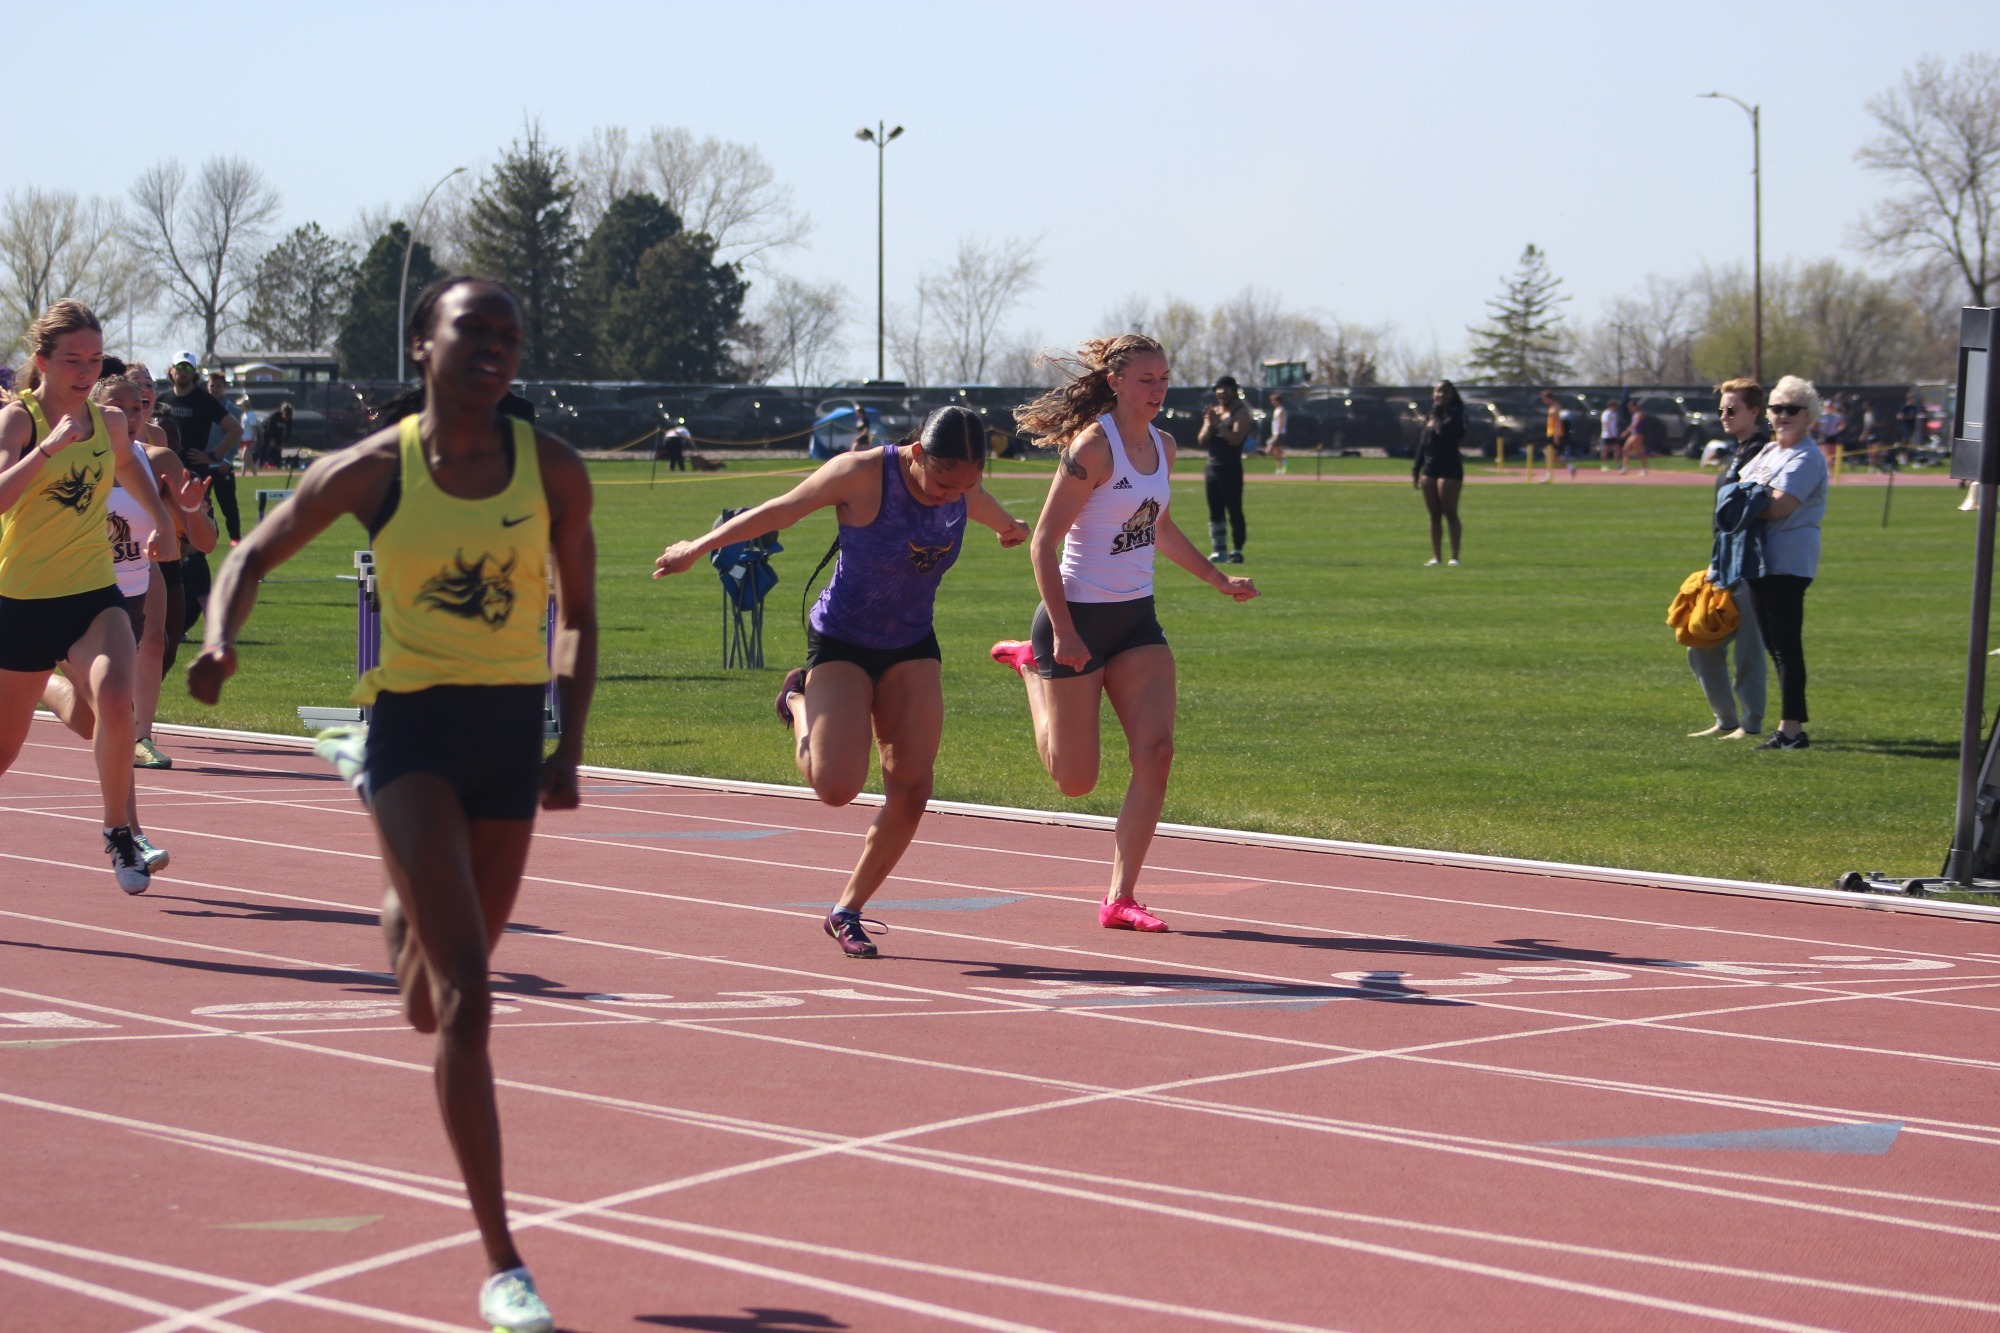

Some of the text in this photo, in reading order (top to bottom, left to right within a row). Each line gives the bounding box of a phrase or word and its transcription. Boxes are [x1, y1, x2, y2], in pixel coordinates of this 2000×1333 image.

[113, 542, 142, 564] SU
[1645, 955, 1955, 976] 2
[1331, 966, 1633, 987] 3
